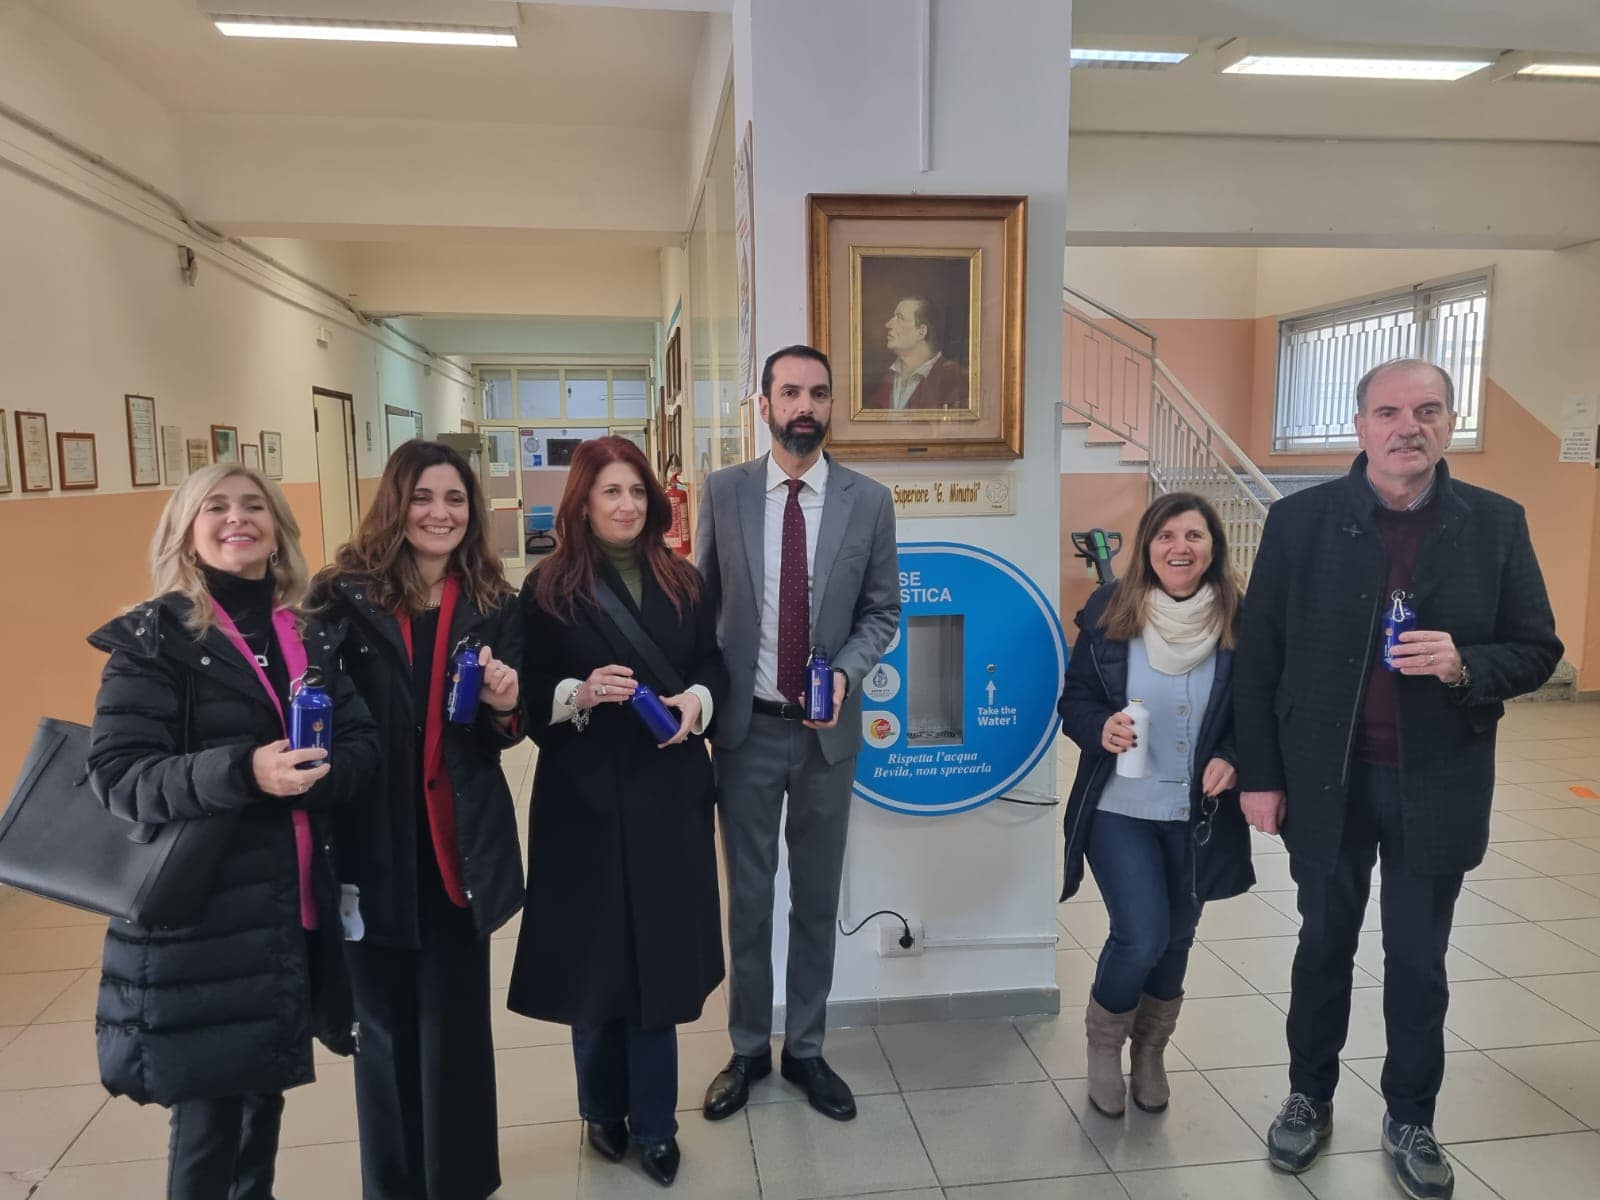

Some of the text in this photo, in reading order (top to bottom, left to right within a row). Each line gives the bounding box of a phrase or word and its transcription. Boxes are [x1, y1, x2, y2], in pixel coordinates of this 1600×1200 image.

[894, 484, 929, 509] Superiore
[950, 481, 981, 503] Minutoli"
[898, 571, 921, 586] SE
[900, 587, 952, 603] STICA
[977, 705, 1017, 715] Take the
[888, 751, 978, 767] Rispetta l'acqua
[873, 762, 992, 778] Bevila, non sprecarla
